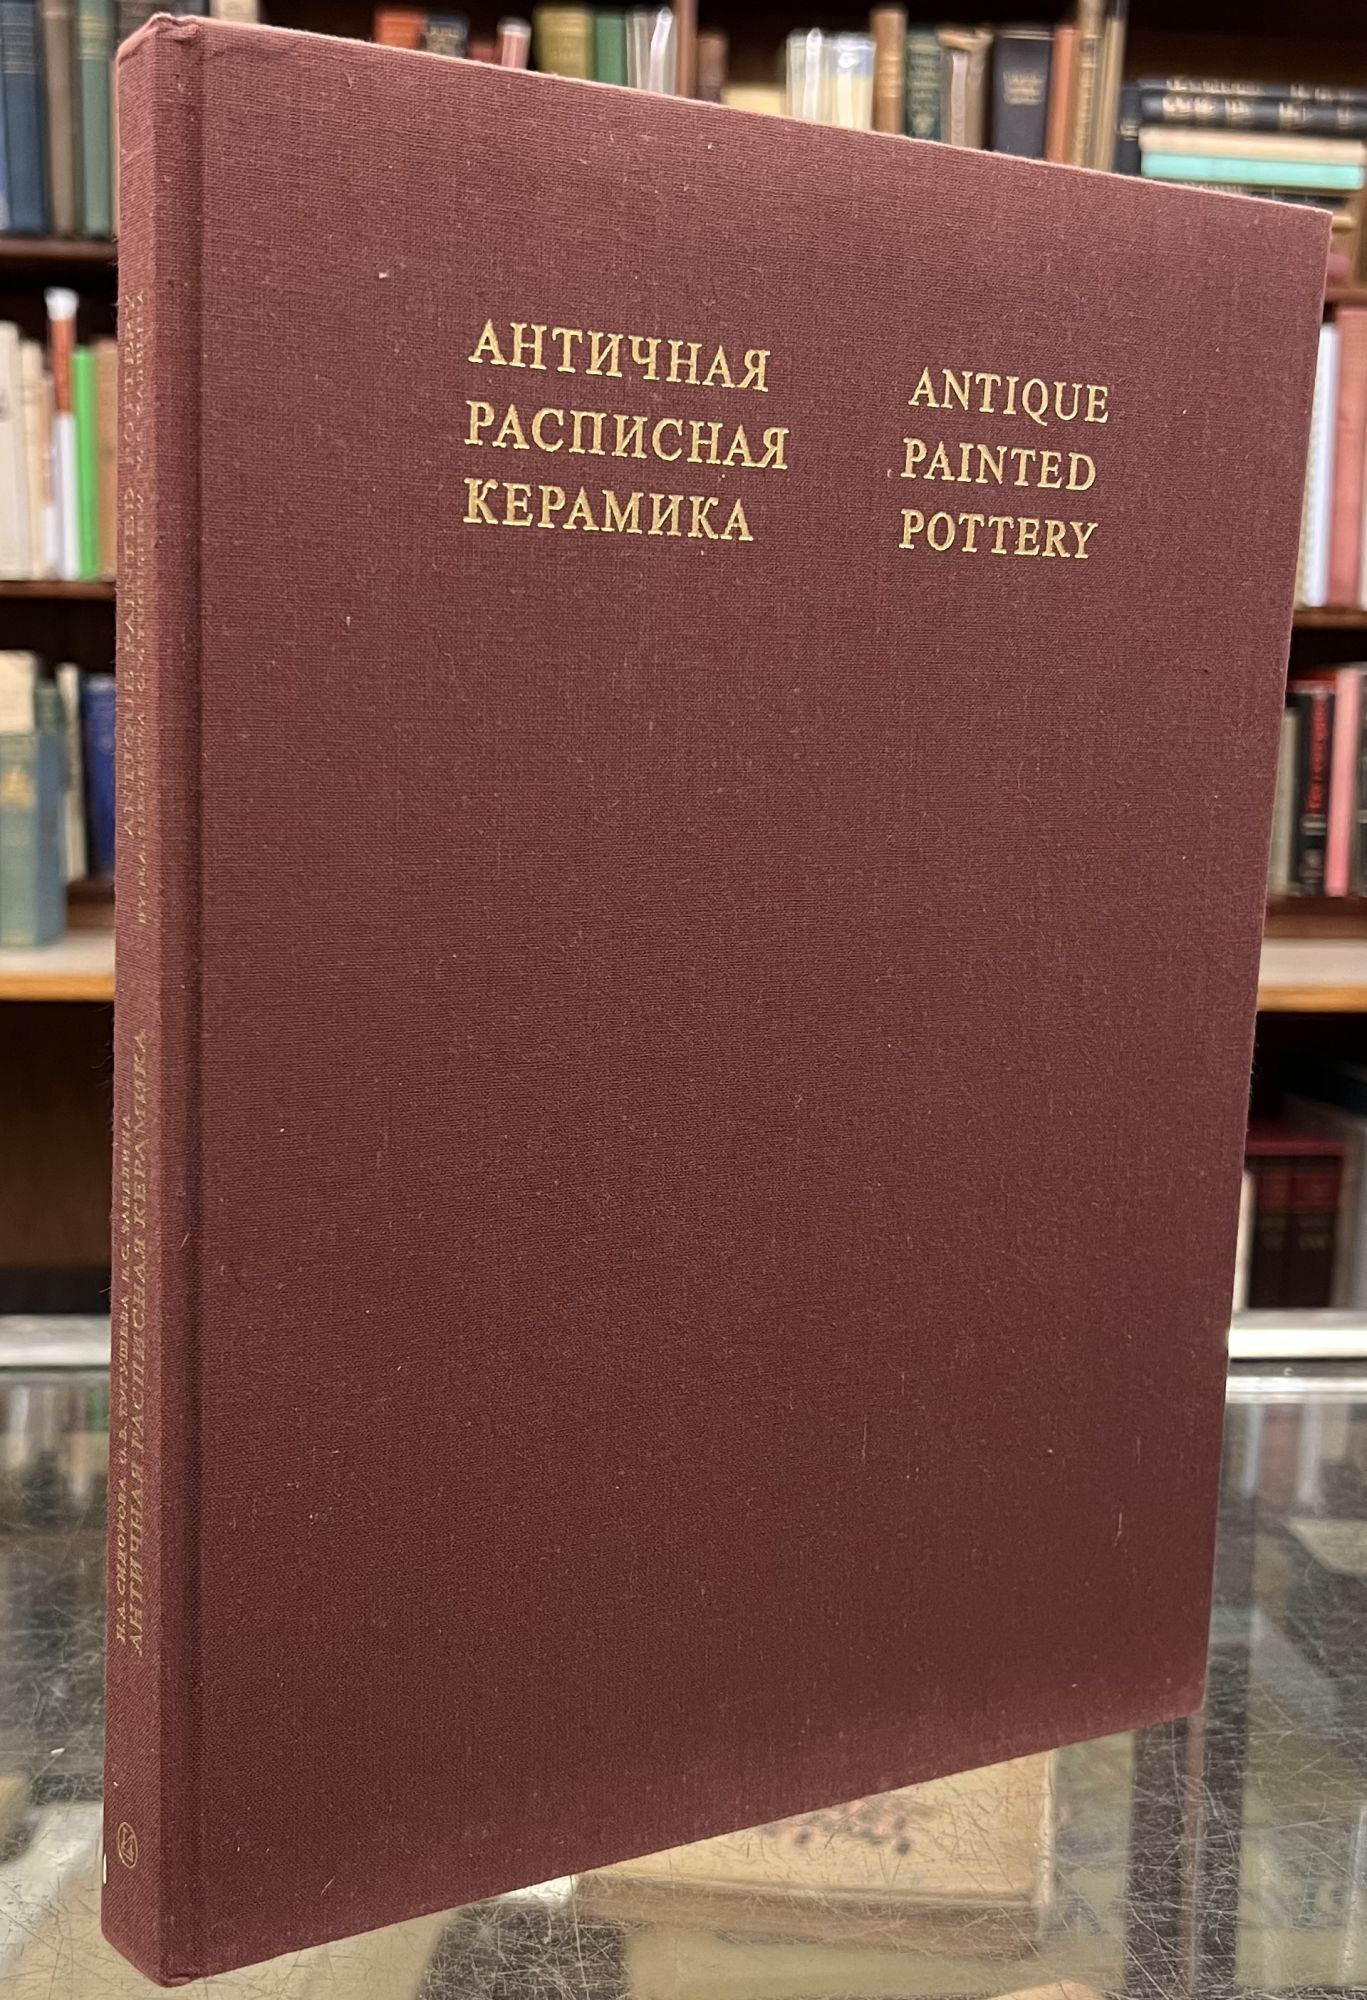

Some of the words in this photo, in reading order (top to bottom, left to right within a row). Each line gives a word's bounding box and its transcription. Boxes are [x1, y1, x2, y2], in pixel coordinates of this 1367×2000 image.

[468, 319, 770, 392] АНТИЧНАЯ
[908, 367, 1108, 426] ANTIQUE
[464, 401, 789, 469] РАСПИСНАЯ
[901, 438, 1095, 490] PAINTED
[463, 478, 753, 541] КЕРАМИКА
[899, 509, 1098, 558] POTTERY
[132, 1028, 146, 1230] КЕРАМИКА
[130, 1239, 145, 1455] РАСПИСНАЯ
[115, 1478, 127, 1597] СИДОРОВА
[128, 1462, 142, 1658] АНТИЧНАЯ
